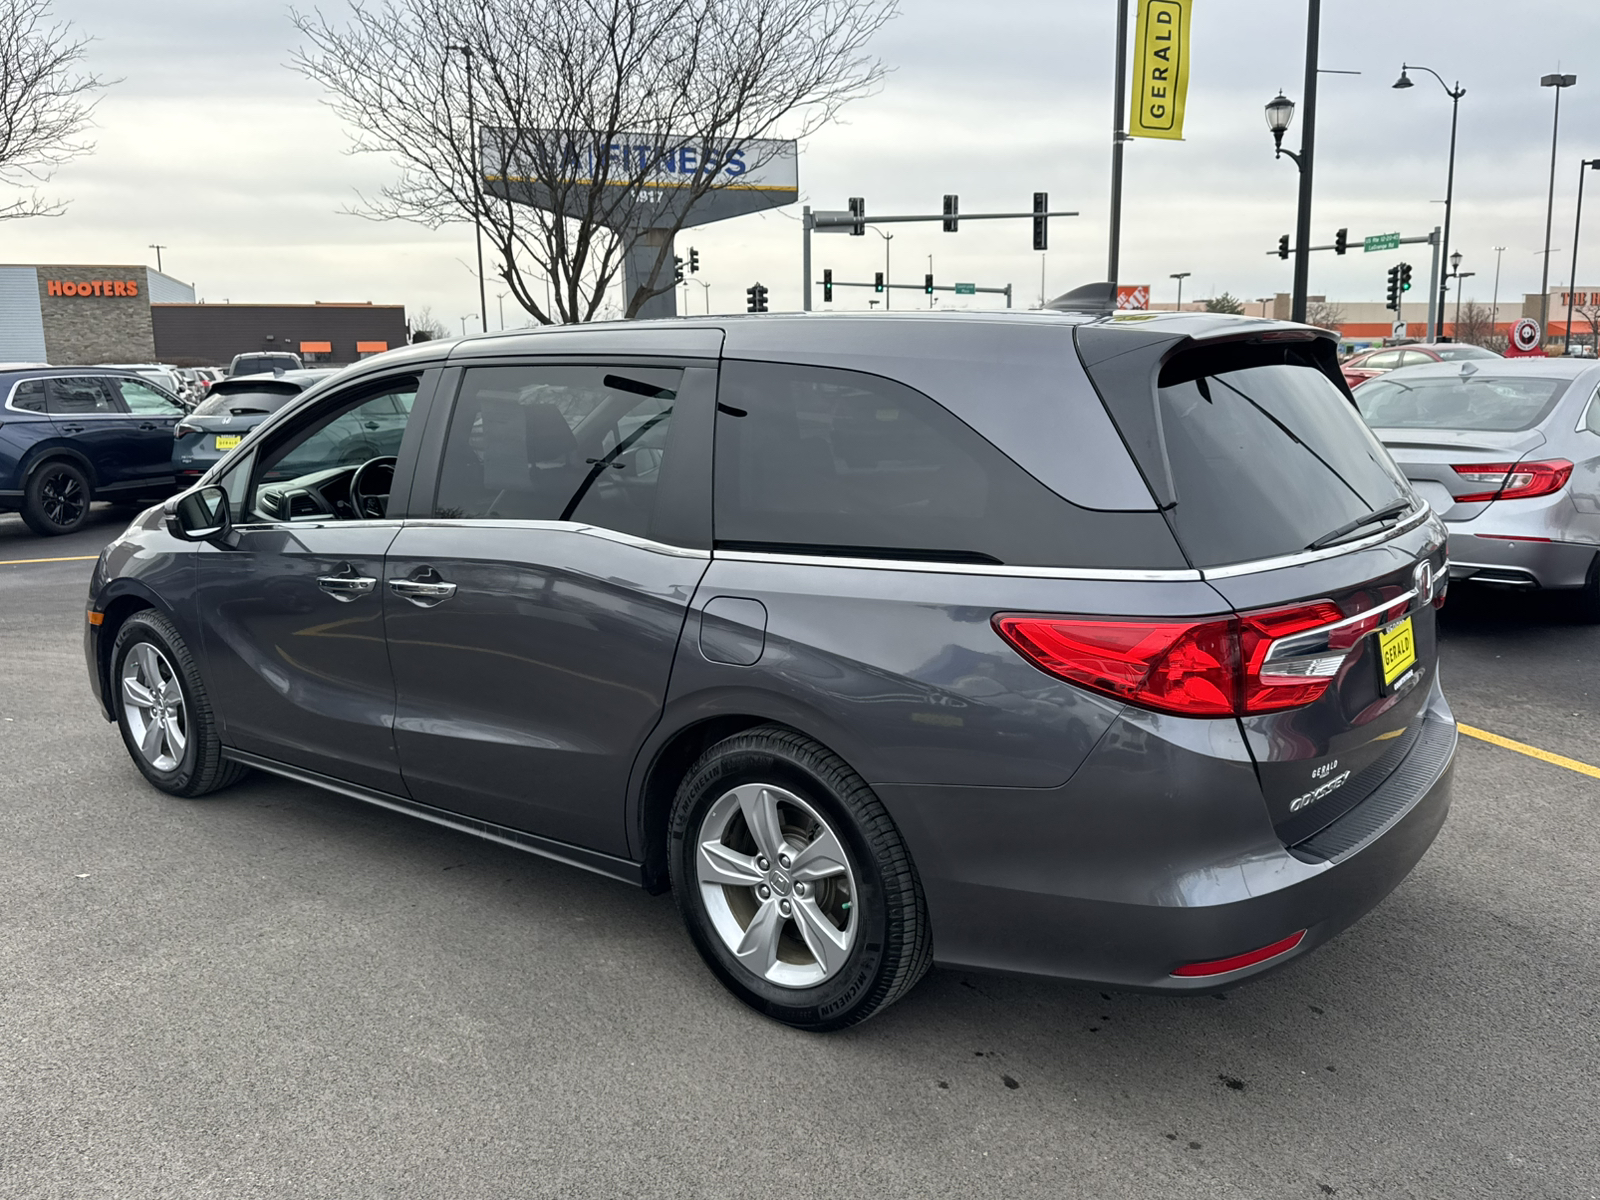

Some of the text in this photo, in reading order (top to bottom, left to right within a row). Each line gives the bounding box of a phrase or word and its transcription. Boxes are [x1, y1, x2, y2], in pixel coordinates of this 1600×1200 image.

[1150, 11, 1172, 118] GERALD
[601, 143, 746, 176] FITNESS
[47, 279, 138, 297] HOOTERS
[1385, 637, 1410, 667] GERALD
[1311, 759, 1338, 779] GERALD
[683, 765, 720, 815] MICHELIN
[1289, 770, 1351, 812] ODYSSEY
[820, 970, 868, 1017] MICHELIN
